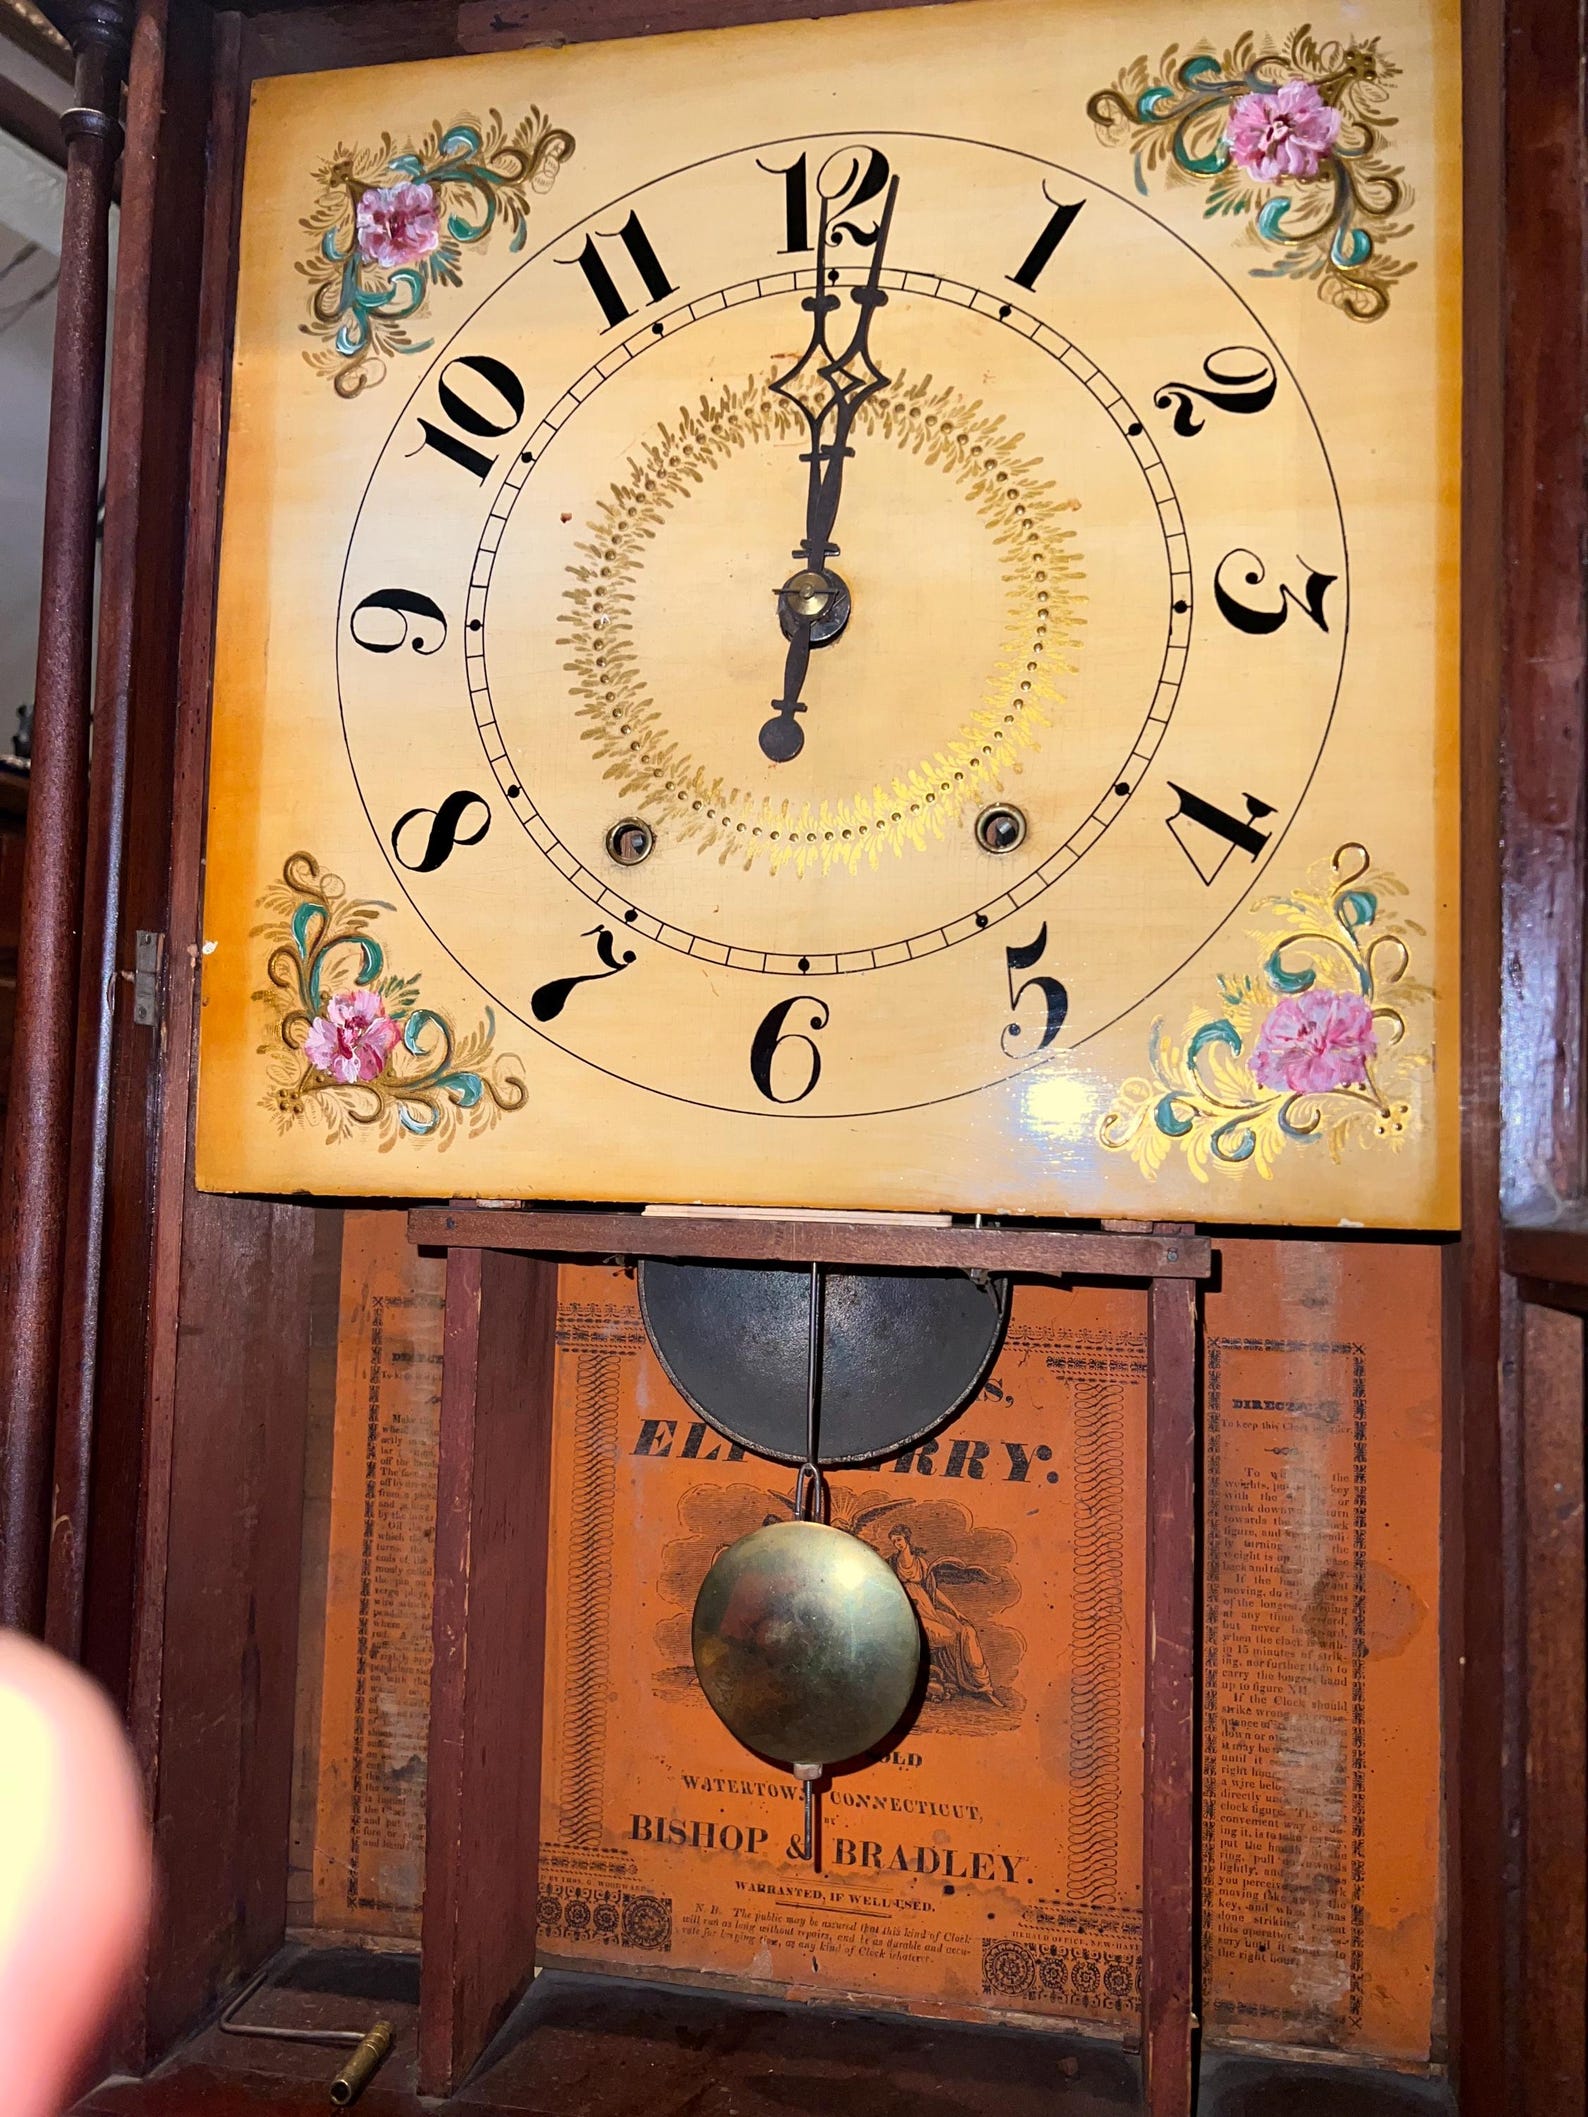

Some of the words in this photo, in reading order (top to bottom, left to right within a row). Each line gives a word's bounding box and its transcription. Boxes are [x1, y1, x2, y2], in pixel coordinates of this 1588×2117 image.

[756, 144, 890, 254] 12
[1004, 178, 1087, 293] 1
[553, 209, 680, 335] 11
[1153, 345, 1277, 437] 2
[404, 355, 525, 488] 10
[1214, 548, 1338, 635] 3
[350, 588, 447, 655] 9
[391, 790, 491, 872] 8
[1165, 780, 1279, 886] 4
[531, 924, 637, 1022] 7
[1000, 921, 1069, 1060] 5
[750, 995, 830, 1104] 6
[1245, 1467, 1260, 1478] To
[1332, 1472, 1349, 1482] the
[1260, 1492, 1278, 1501] the
[1224, 1503, 1254, 1513] crank
[1224, 1515, 1267, 1525] towards
[1224, 1526, 1258, 1538] figure,
[1262, 1529, 1280, 1538] and
[1244, 1540, 1282, 1552] turning
[1224, 1550, 1261, 1561] weight
[1249, 1563, 1268, 1571] and
[1236, 1574, 1245, 1584] If
[1254, 1576, 1271, 1585] the
[1223, 1587, 1266, 1598] moving,
[1269, 1587, 1282, 1598] do
[1223, 1598, 1234, 1609] of
[1237, 1599, 1254, 1608] the
[1223, 1610, 1233, 1618] at
[1241, 1612, 1260, 1621] any
[1222, 1619, 1240, 1630] but
[1251, 1623, 1280, 1633] never
[1222, 1633, 1251, 1643] when
[1256, 1635, 1272, 1644] the
[1238, 1645, 1249, 1654] 15
[1253, 1647, 1295, 1657] minutes
[1222, 1658, 1242, 1668] ing,
[1266, 1659, 1304, 1671] further
[1337, 1664, 1347, 1674] to
[1222, 1670, 1249, 1680] carry
[1257, 1671, 1274, 1680] the
[1222, 1681, 1235, 1692] up
[1240, 1681, 1250, 1690] to
[1252, 1682, 1283, 1694] figure
[1233, 1692, 1244, 1702] If
[1250, 1694, 1266, 1704] the
[1274, 1695, 1305, 1708] Clock
[1222, 1705, 1252, 1715] strike
[1255, 1733, 1266, 1741] or
[1222, 1753, 1246, 1763] until
[1221, 1764, 1247, 1776] right
[1221, 1789, 1261, 1801] directly
[829, 1791, 984, 1824] CONNECTICUT,
[1220, 1801, 1248, 1812] clock
[1220, 1827, 1237, 1838] ing
[1241, 1828, 1252, 1838] it,
[1255, 1829, 1263, 1839] is
[1266, 1830, 1277, 1840] to
[629, 1813, 769, 1854] BISHOP
[786, 1834, 812, 1860] &
[832, 1838, 1034, 1885] BRADLEY.
[1220, 1839, 1238, 1849] put
[1245, 1841, 1262, 1850] the
[1220, 1852, 1245, 1862] ring,
[1254, 1854, 1274, 1865] pull
[1220, 1862, 1258, 1876] lightly,
[1218, 1876, 1238, 1885] you
[736, 1881, 826, 1904] WARRANTED,
[830, 1892, 844, 1902] IF
[848, 1894, 890, 1908] WELL
[896, 1899, 936, 1912] USED.
[1219, 1888, 1258, 1900] moving
[1219, 1898, 1241, 1911] key,
[1248, 1903, 1268, 1912] and
[1218, 1911, 1245, 1922] done
[733, 1908, 750, 1918] The
[755, 1911, 782, 1923] public
[786, 1916, 806, 1927] may
[809, 1917, 818, 1926] be
[861, 1923, 879, 1934] that
[882, 1924, 901, 1936] this
[904, 1927, 926, 1939] kind
[929, 1931, 941, 1942] of
[1218, 1923, 1239, 1934] this
[683, 1914, 701, 1923] will
[722, 1920, 732, 1928] as
[735, 1920, 755, 1932] long
[759, 1923, 794, 1936] without
[798, 1927, 832, 1942] repairs,
[886, 1937, 922, 1950] durable
[924, 1941, 943, 1953] and
[946, 1945, 971, 1956] accu-
[785, 1939, 796, 1947] as
[798, 1941, 816, 1952] any
[819, 1940, 842, 1951] kind
[844, 1946, 854, 1956] of
[858, 1947, 886, 1959] Clock
[889, 1950, 934, 1963] whatever.
[1218, 1947, 1235, 1959] the
[1240, 1949, 1266, 1963] right
[1335, 1950, 1347, 1960] to
